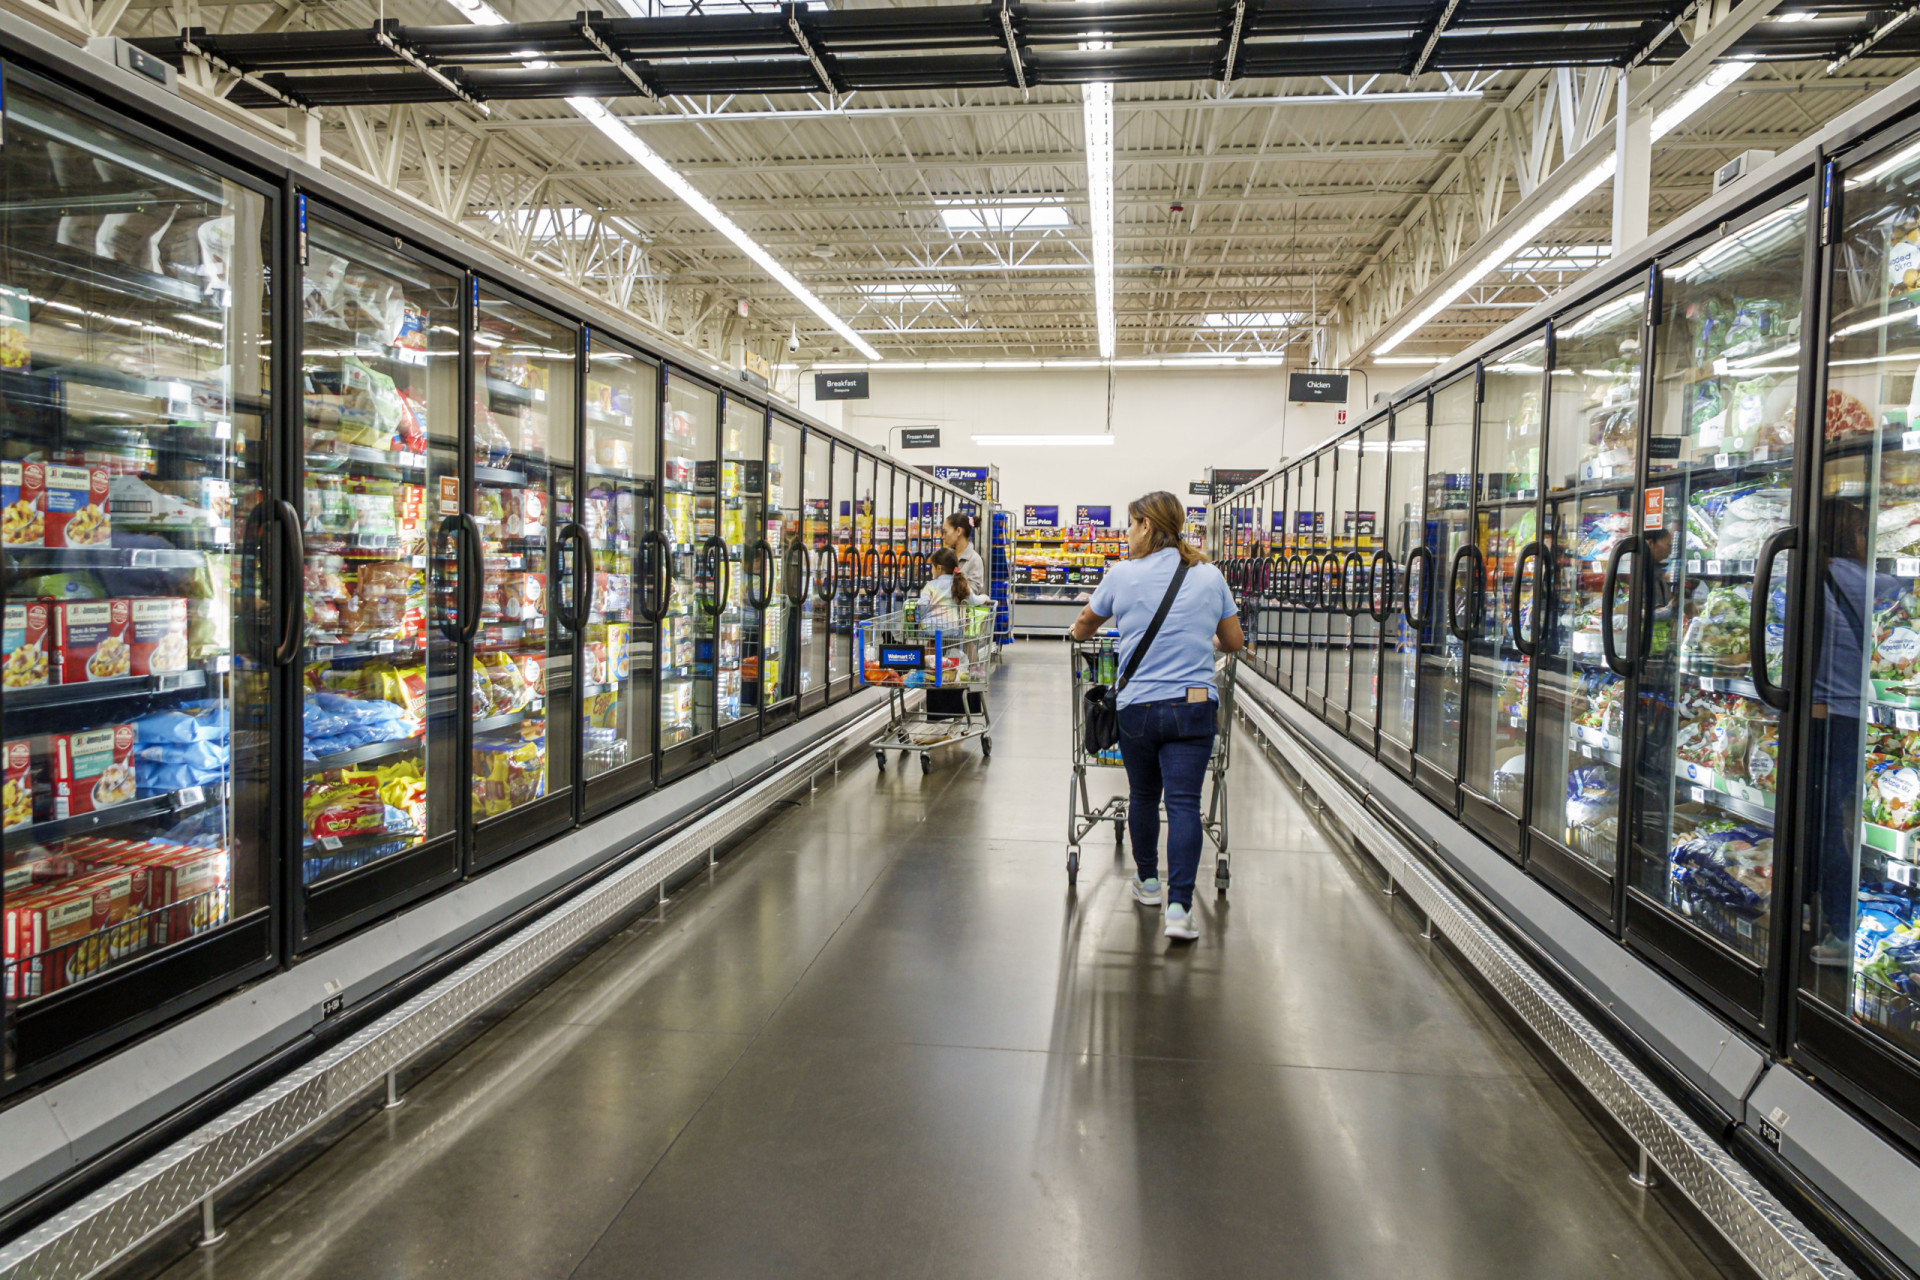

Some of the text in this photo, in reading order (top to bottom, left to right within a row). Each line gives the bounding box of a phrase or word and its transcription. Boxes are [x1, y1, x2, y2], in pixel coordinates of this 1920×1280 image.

[946, 470, 977, 479] Low Price
[444, 485, 456, 496] WIC
[1648, 496, 1660, 508] WIC
